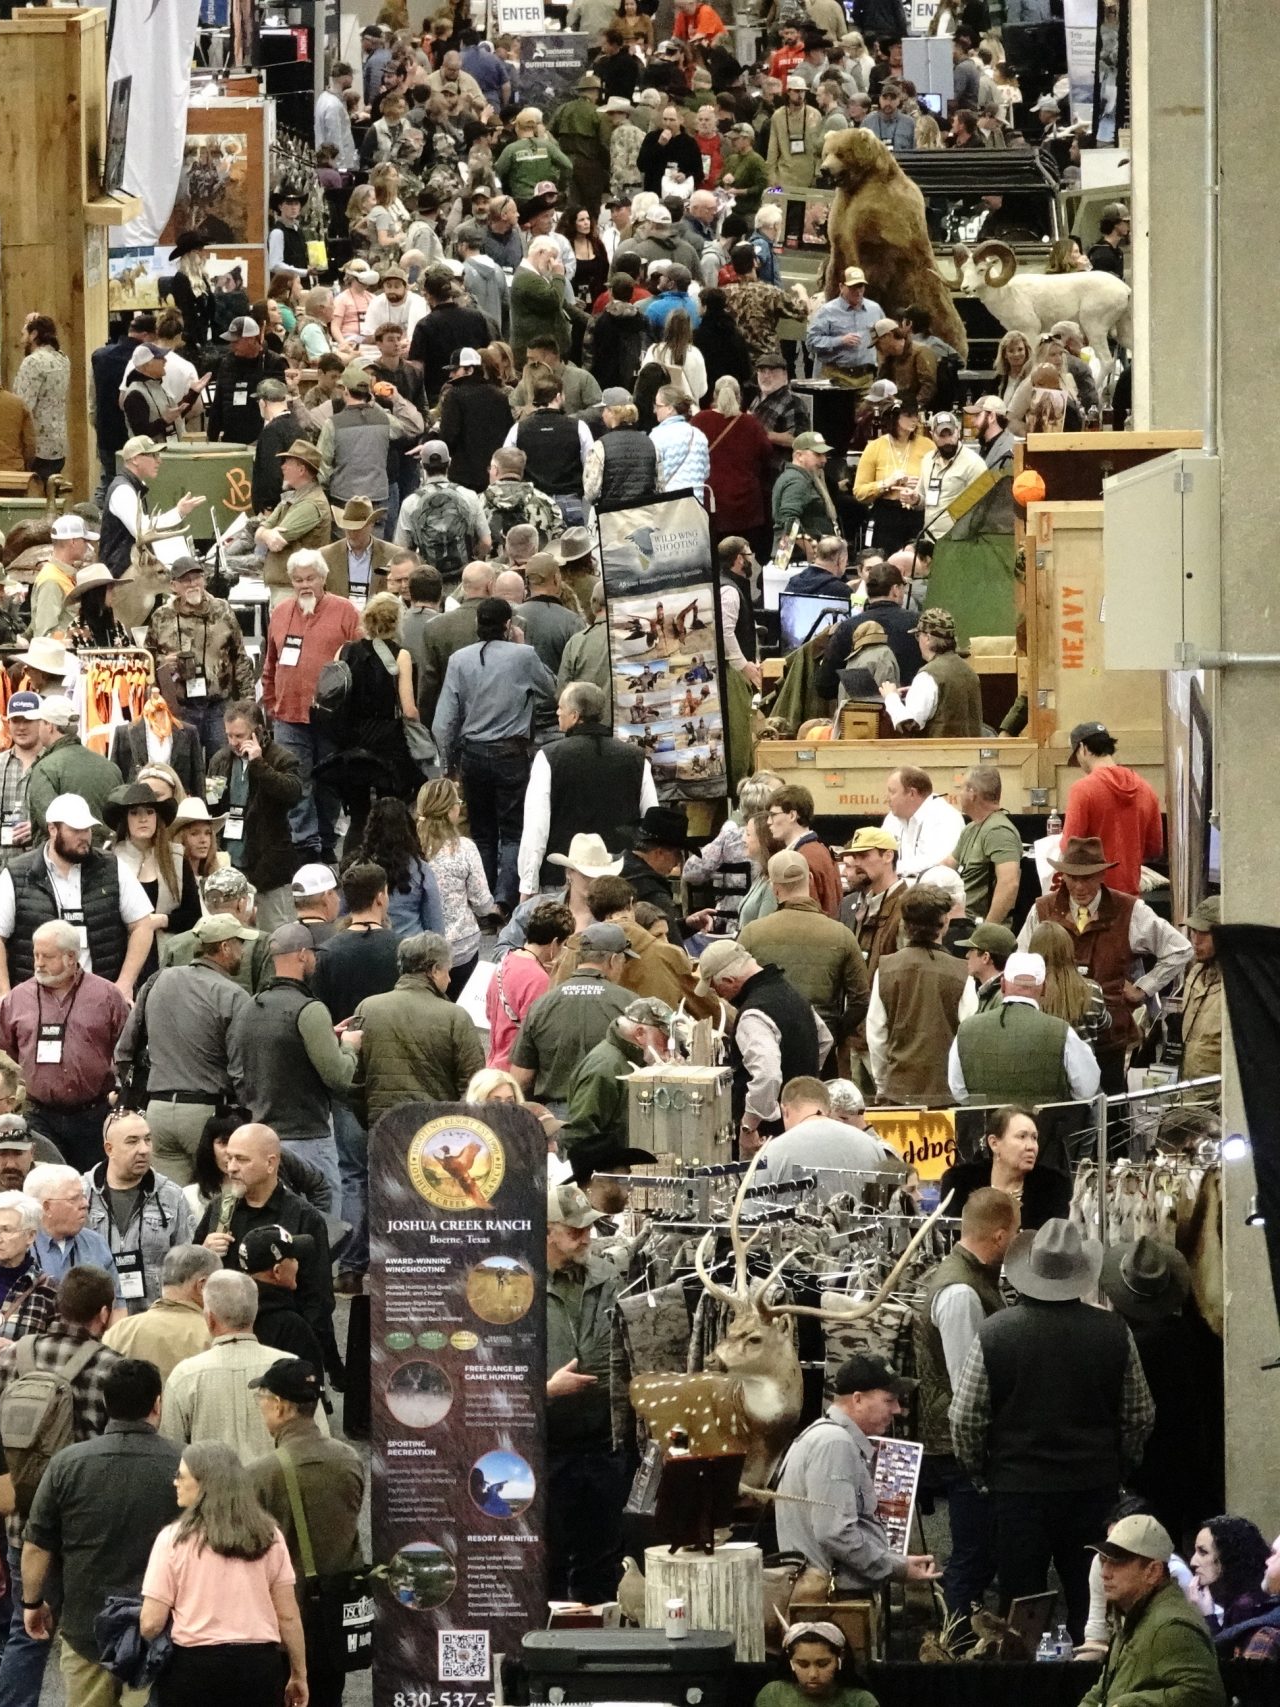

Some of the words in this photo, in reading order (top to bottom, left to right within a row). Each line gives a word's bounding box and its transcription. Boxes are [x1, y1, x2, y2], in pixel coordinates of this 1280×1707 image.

[502, 7, 540, 20] ENTER
[654, 533, 677, 543] WILD
[679, 529, 698, 539] WING
[655, 539, 698, 553] SHOOTING
[1062, 586, 1084, 669] HEAVY
[411, 1163, 432, 1199] JOSHUA
[435, 1197, 467, 1208] CREEK
[482, 1162, 502, 1195] RANCH
[387, 1220, 437, 1233] JOSHUA
[440, 1220, 483, 1231] CREEK
[485, 1220, 531, 1231] RANCH
[430, 1235, 463, 1244] Boerne,
[467, 1235, 490, 1244] Texas
